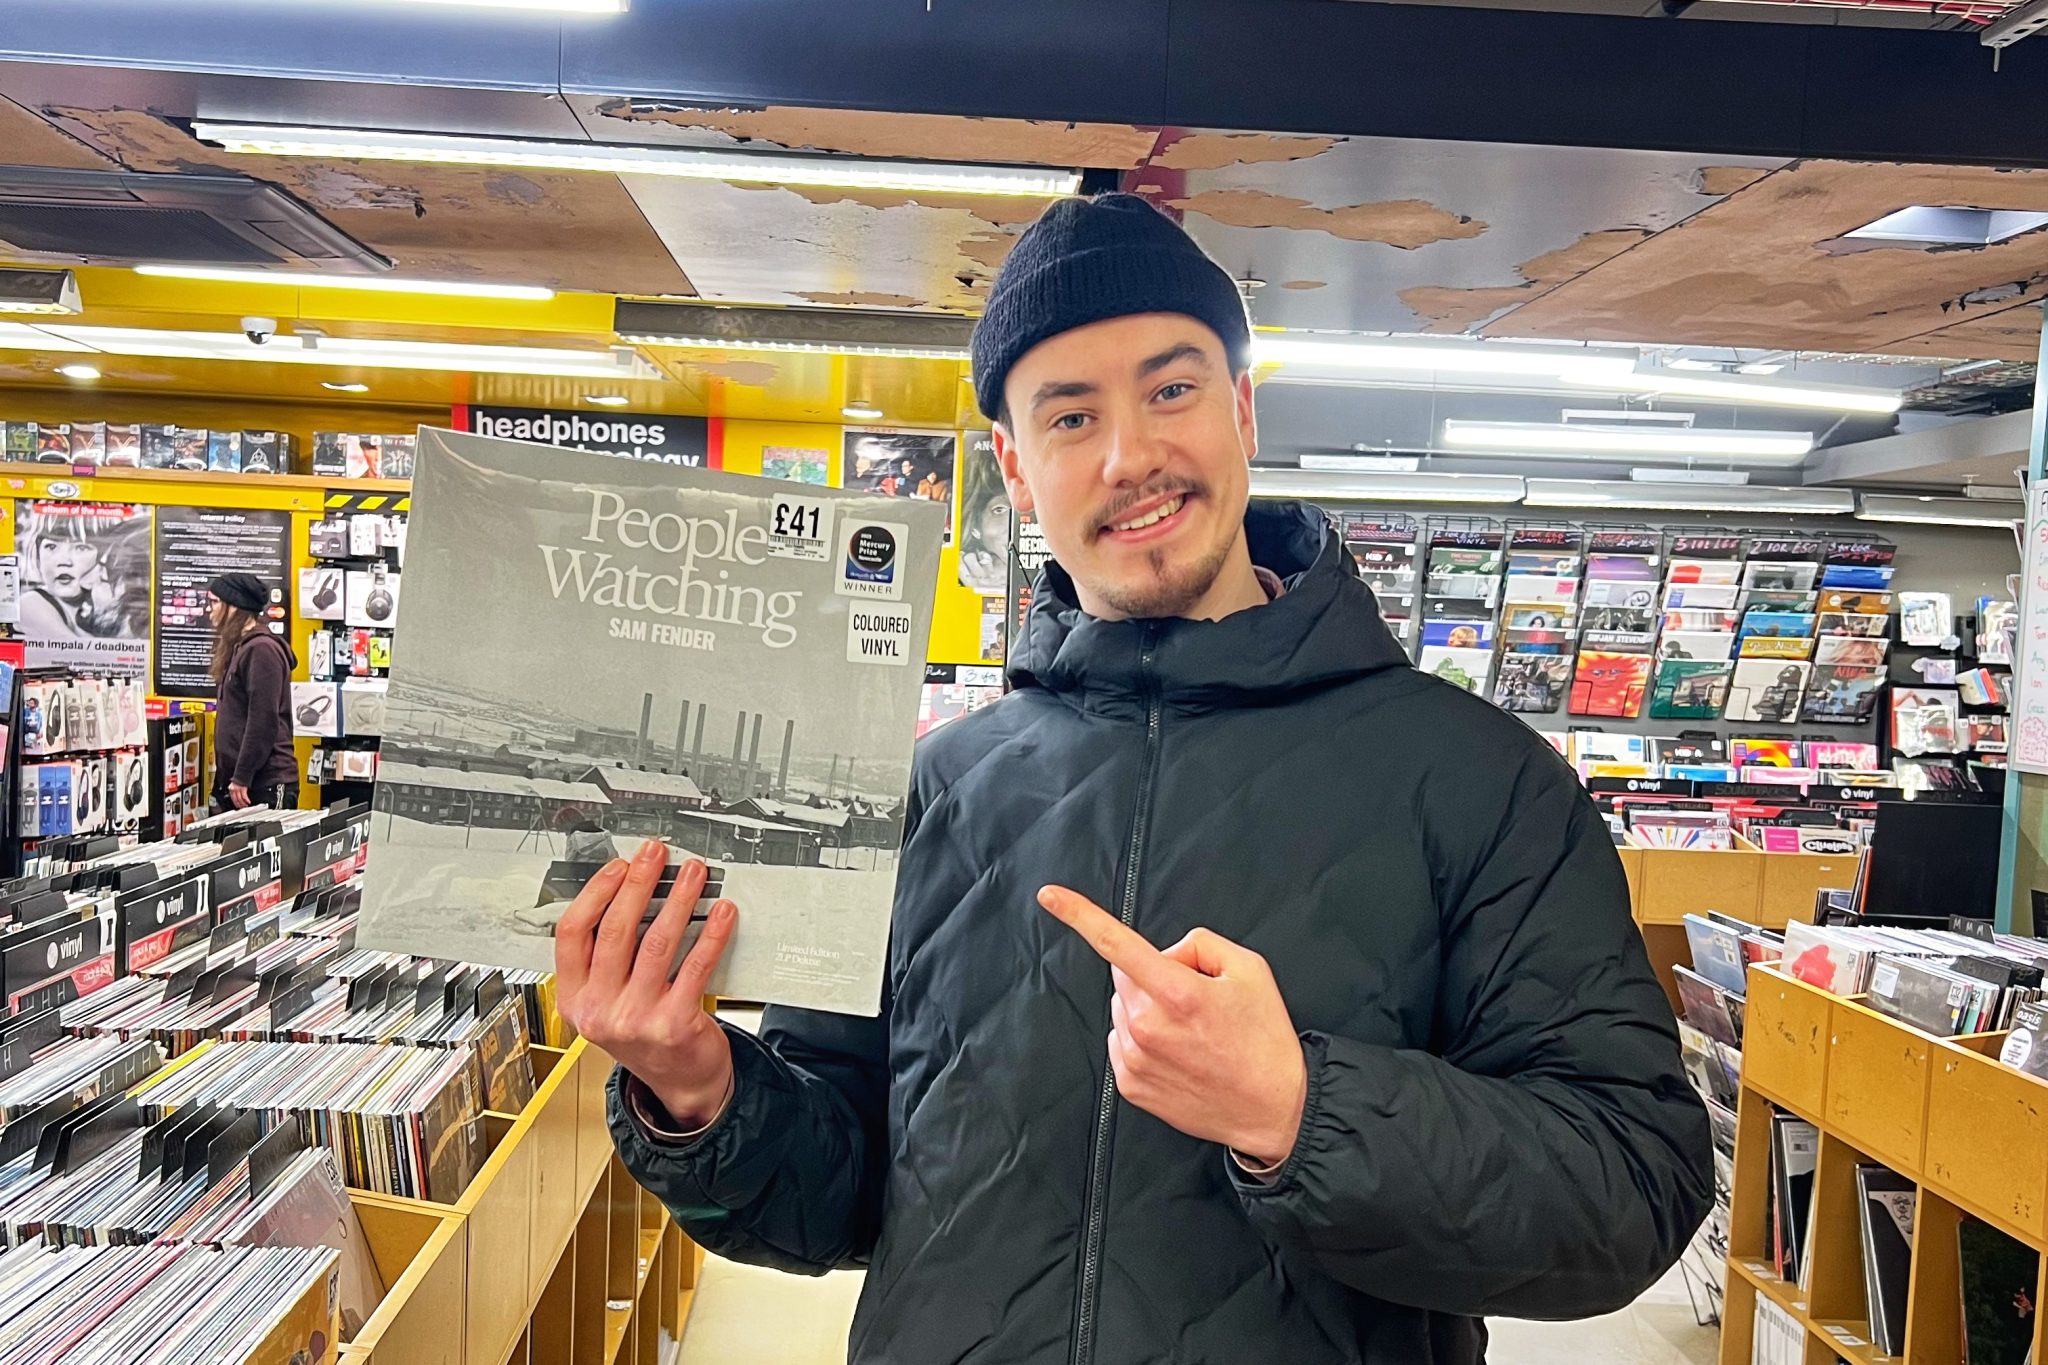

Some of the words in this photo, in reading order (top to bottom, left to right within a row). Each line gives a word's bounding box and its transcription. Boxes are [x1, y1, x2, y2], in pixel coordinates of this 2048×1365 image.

[476, 410, 665, 446] headphones
[42, 506, 69, 514] album
[81, 507, 95, 515] the
[96, 508, 124, 516] month
[774, 503, 820, 538] £41
[578, 487, 768, 571] People
[858, 547, 878, 556] Prize
[859, 539, 891, 552] Mercury
[1019, 537, 1052, 553] RECOR
[538, 544, 803, 648] Watching
[844, 582, 892, 594] WINNER
[609, 617, 647, 641] SAM
[651, 623, 716, 651] FENDER
[853, 614, 909, 634] COLOURED
[24, 640, 45, 649] ame
[47, 641, 83, 651] impala
[94, 641, 145, 653] deadbeat
[861, 637, 900, 658] VINYL
[1640, 781, 1661, 792] vinyl
[1852, 789, 1874, 799] vinyl
[1752, 817, 1775, 826] FILM
[332, 837, 345, 856] vinyl
[272, 850, 280, 873] K
[246, 861, 261, 883] vinyl
[166, 891, 184, 916] vinyl
[60, 932, 83, 960] vinyl
[2016, 1008, 2043, 1026] oasis
[104, 1067, 115, 1093] H
[124, 1054, 136, 1085] H
[142, 1045, 152, 1075] H
